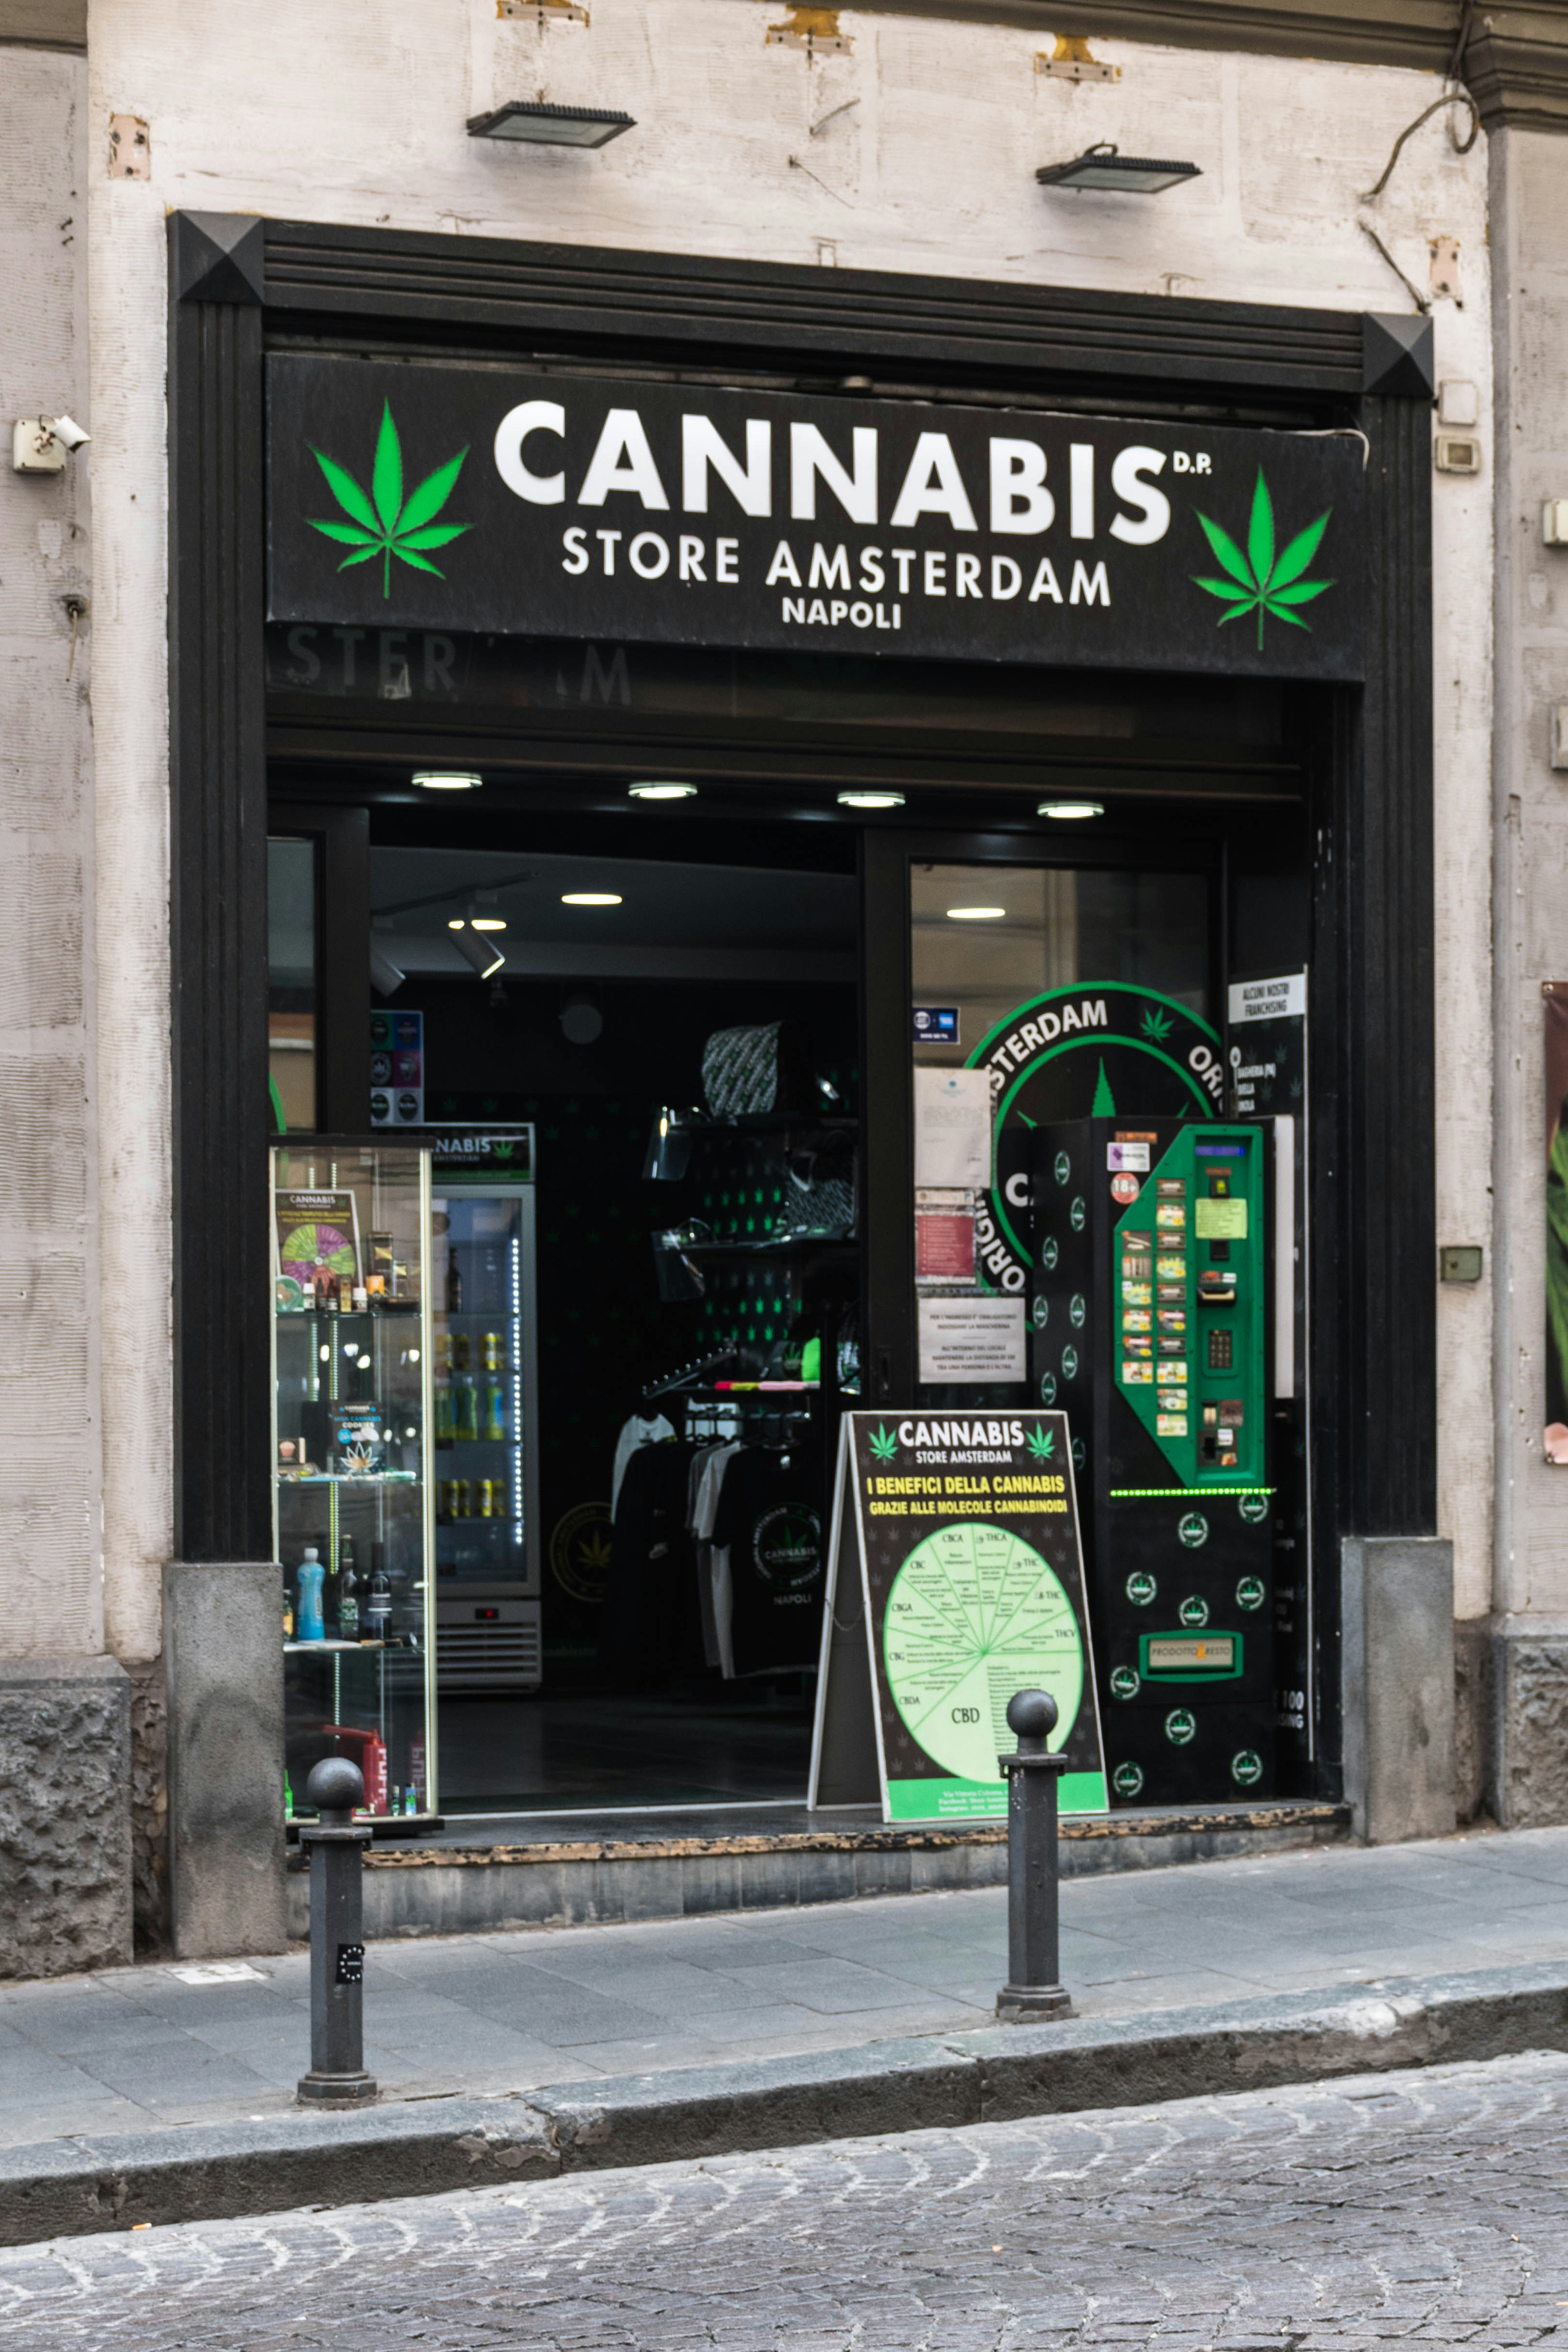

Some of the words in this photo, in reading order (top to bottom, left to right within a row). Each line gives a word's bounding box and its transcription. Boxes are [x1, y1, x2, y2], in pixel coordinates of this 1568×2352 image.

[494, 399, 1171, 546] CANNABIS
[1172, 450, 1213, 476] D.P.
[561, 526, 740, 584] STORE
[765, 540, 1111, 607] AMSTERDAM
[782, 596, 901, 630] NAPOLI
[1188, 1045, 1224, 1113] ORI
[430, 1138, 491, 1152] NABIS
[1113, 1179, 1137, 1193] 18+
[289, 1195, 336, 1204] CANNABIS
[898, 1420, 1025, 1447] CANNABIS
[915, 1450, 948, 1464] STORE
[950, 1450, 1012, 1464] AMSTERDAM
[867, 1477, 873, 1495] I
[875, 1476, 942, 1495] BENEFICI
[944, 1476, 991, 1494] DELLA
[992, 1475, 1065, 1494] CANNABIS
[869, 1501, 908, 1516] GRAZIE
[909, 1501, 936, 1515] ALLE
[937, 1500, 993, 1515] MOLECOLE
[993, 1499, 1068, 1514] CANNABINOIDI
[942, 1533, 964, 1543] CBCA
[986, 1533, 1007, 1541] THCA
[910, 1560, 926, 1569] CBC
[773, 1593, 812, 1606] NAPOLI
[951, 1707, 980, 1724] CBD
